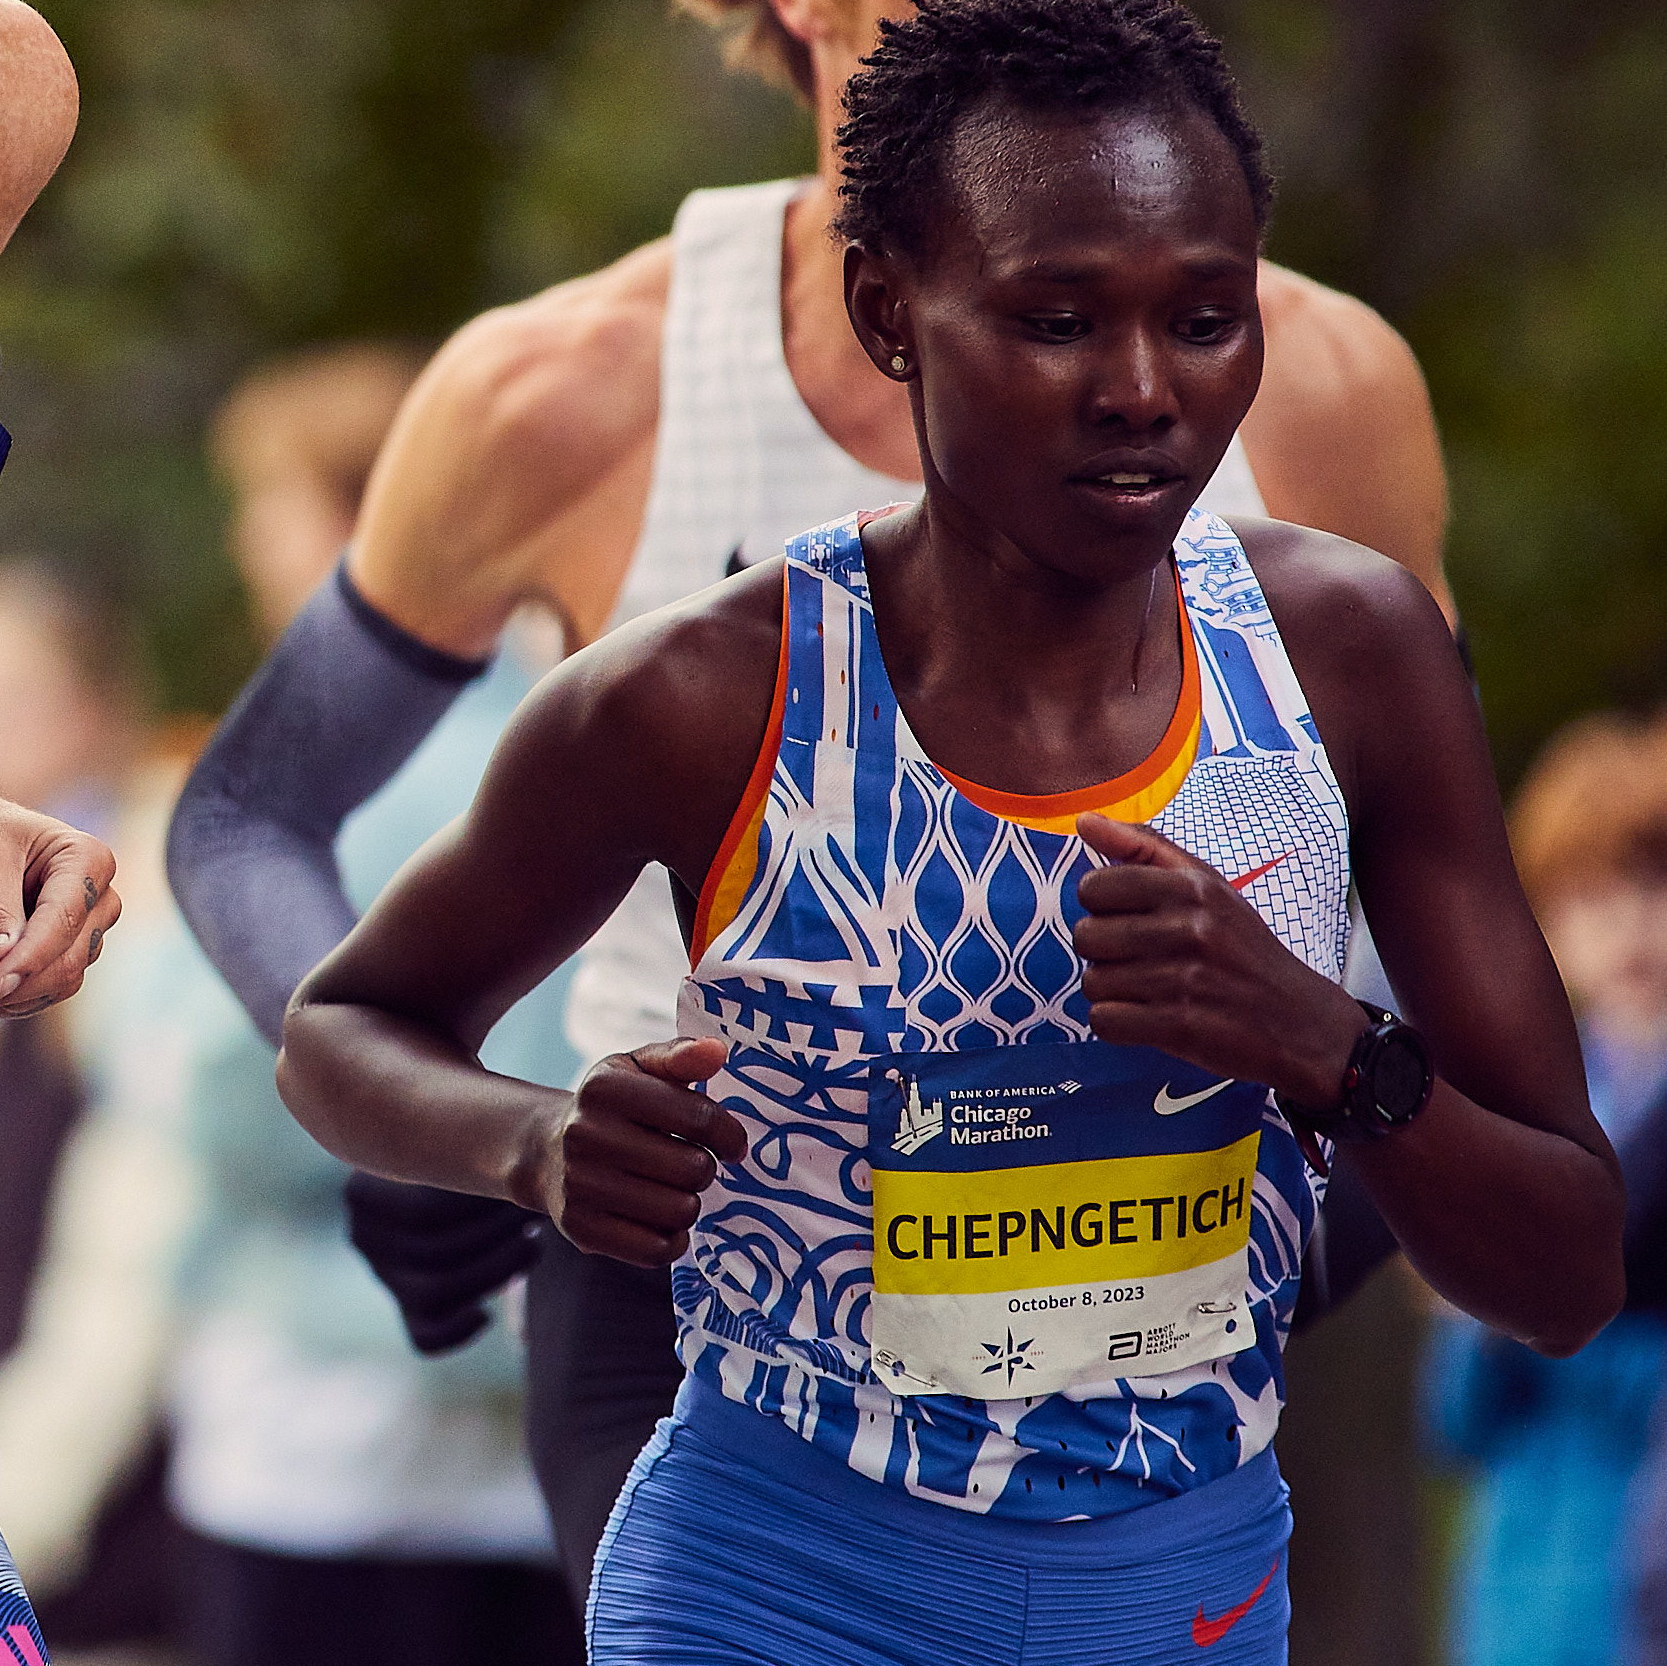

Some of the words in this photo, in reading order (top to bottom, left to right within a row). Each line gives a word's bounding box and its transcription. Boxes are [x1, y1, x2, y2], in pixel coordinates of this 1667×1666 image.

[949, 1090, 983, 1100] BANK
[985, 1089, 1001, 1098] OF
[1002, 1086, 1057, 1097] AMERICA
[950, 1104, 1032, 1125] Chicago
[950, 1123, 1050, 1145] Marathon
[886, 1177, 1246, 1261] CHEPNGETICH
[1008, 1294, 1077, 1313] October
[1081, 1291, 1098, 1308] 8,
[1102, 1285, 1145, 1304] 2023
[1146, 1332, 1190, 1348] MARATHON
